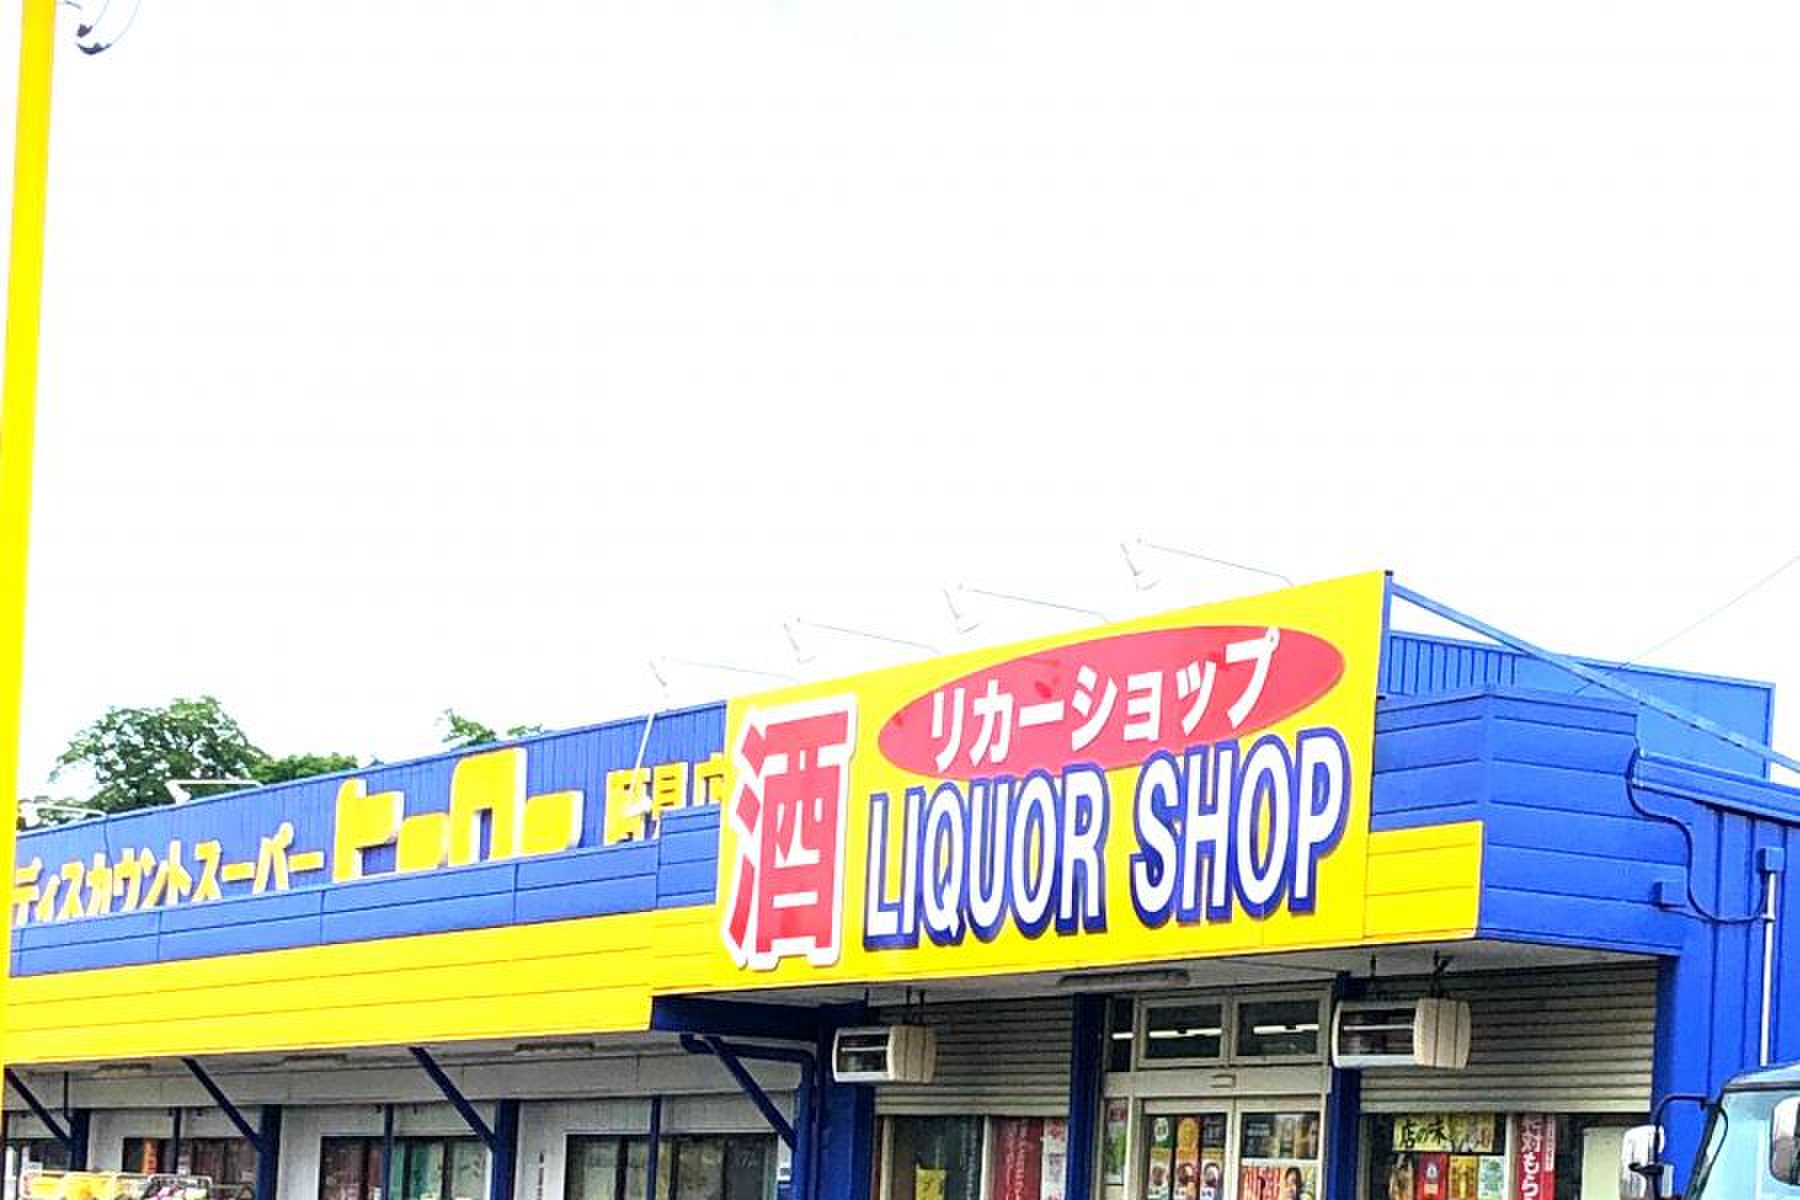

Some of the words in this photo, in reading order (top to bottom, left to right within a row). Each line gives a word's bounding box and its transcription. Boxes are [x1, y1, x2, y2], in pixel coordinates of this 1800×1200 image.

[931, 627, 1281, 772] リカーショップ
[722, 692, 858, 971] 酒
[863, 762, 1110, 950] LIQUOR
[1130, 727, 1348, 929] SHOP
